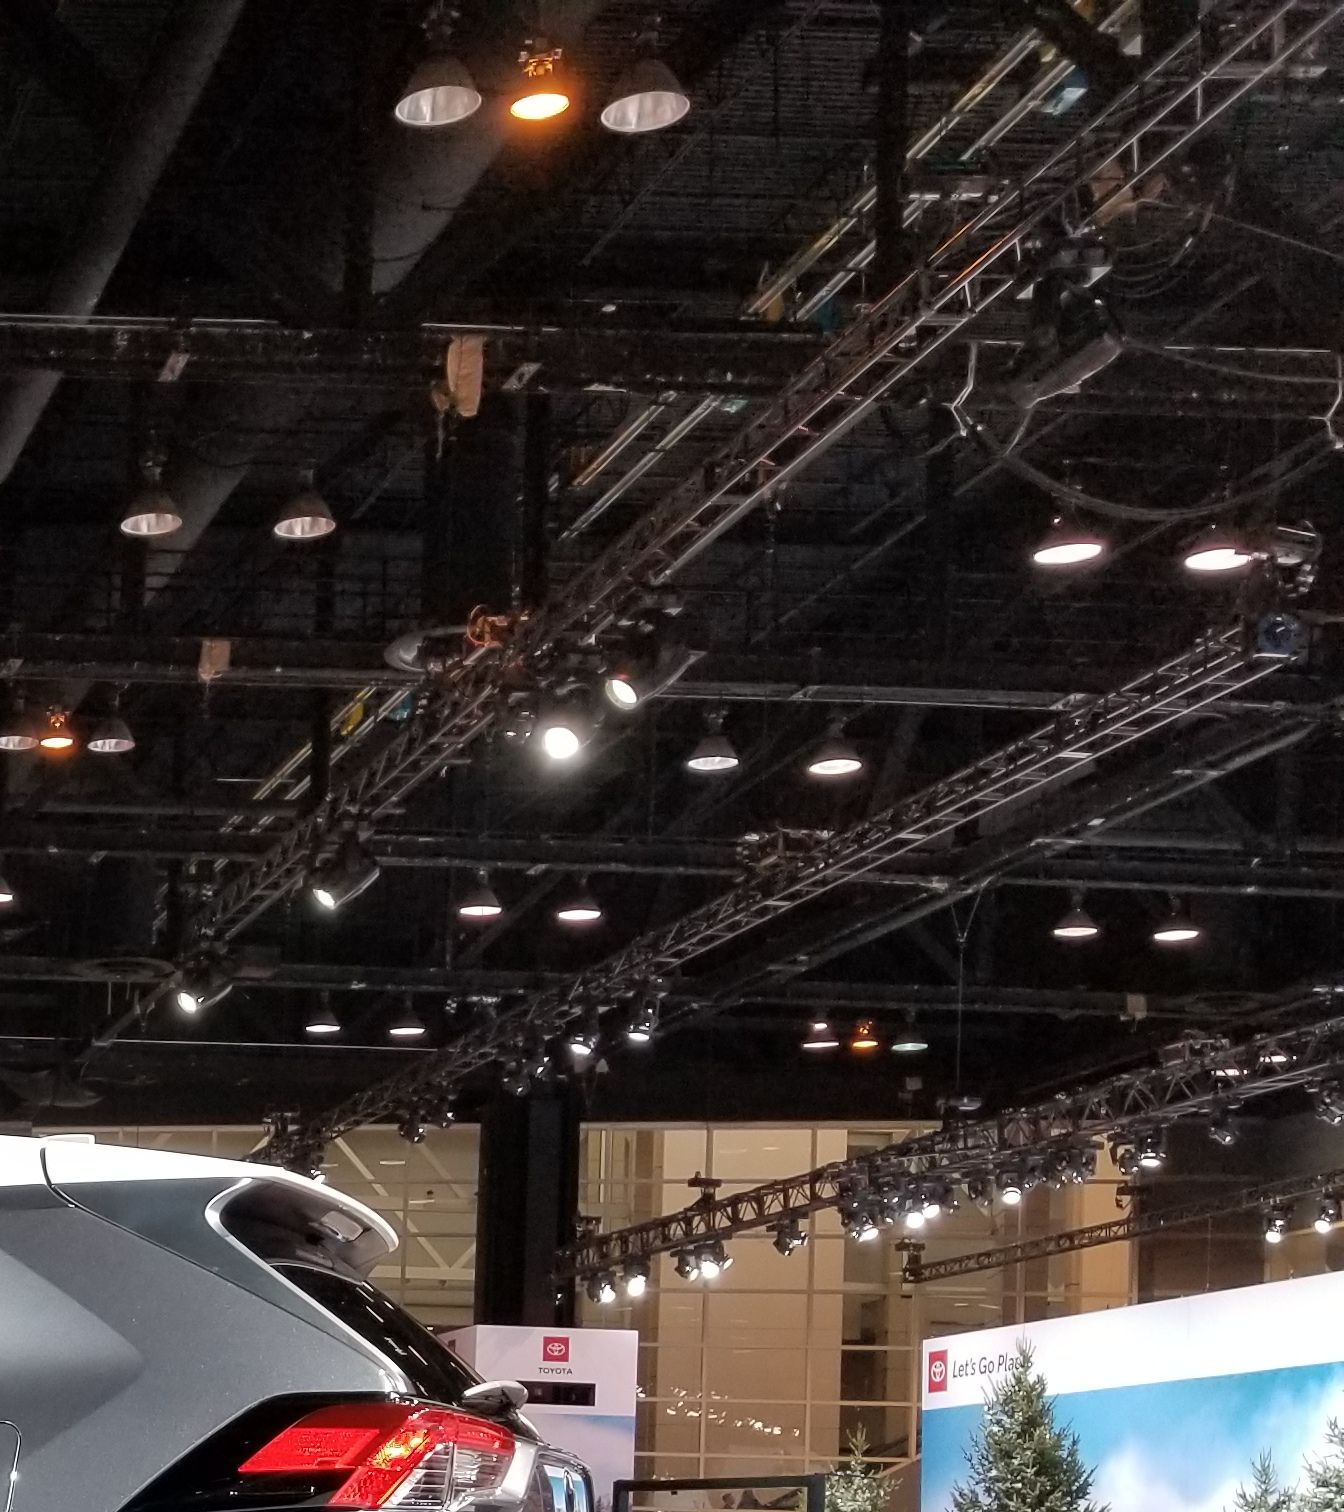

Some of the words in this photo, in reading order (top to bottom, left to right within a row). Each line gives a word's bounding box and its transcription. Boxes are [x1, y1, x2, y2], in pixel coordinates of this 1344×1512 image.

[538, 1367, 573, 1375] TOYOTA
[952, 1358, 976, 1378] Let's
[978, 1356, 995, 1375] Go
